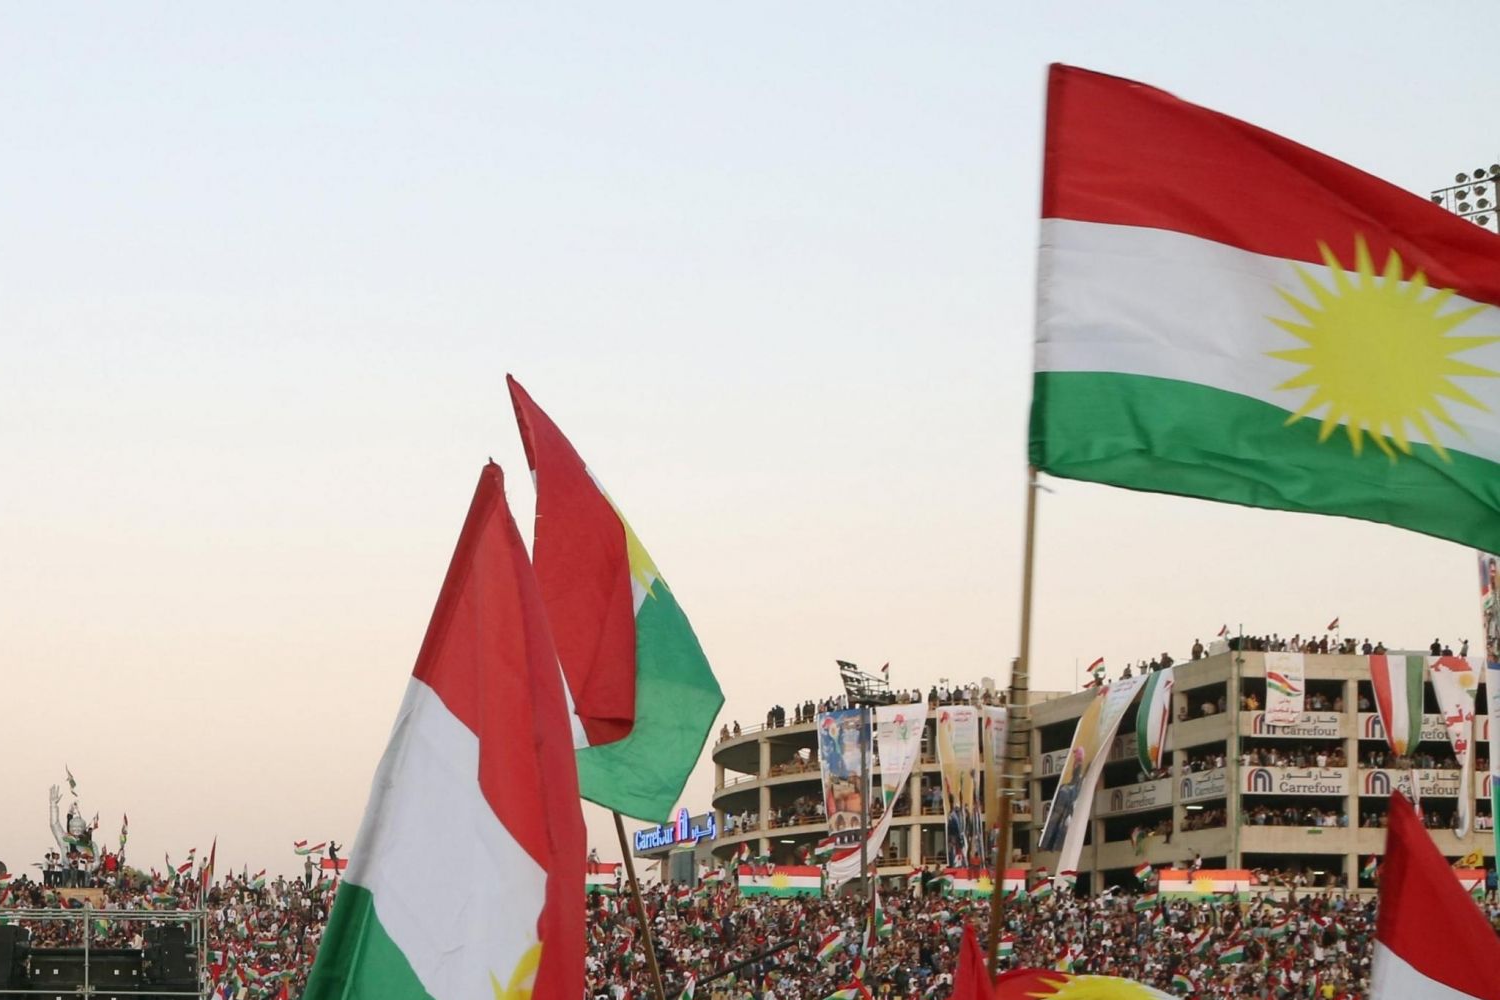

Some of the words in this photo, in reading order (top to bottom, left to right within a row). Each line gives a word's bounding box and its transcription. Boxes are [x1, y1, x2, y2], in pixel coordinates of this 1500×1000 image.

[1280, 725, 1337, 736] Carrefour
[1280, 782, 1342, 793] Carrefour
[1398, 783, 1459, 795] Carefour
